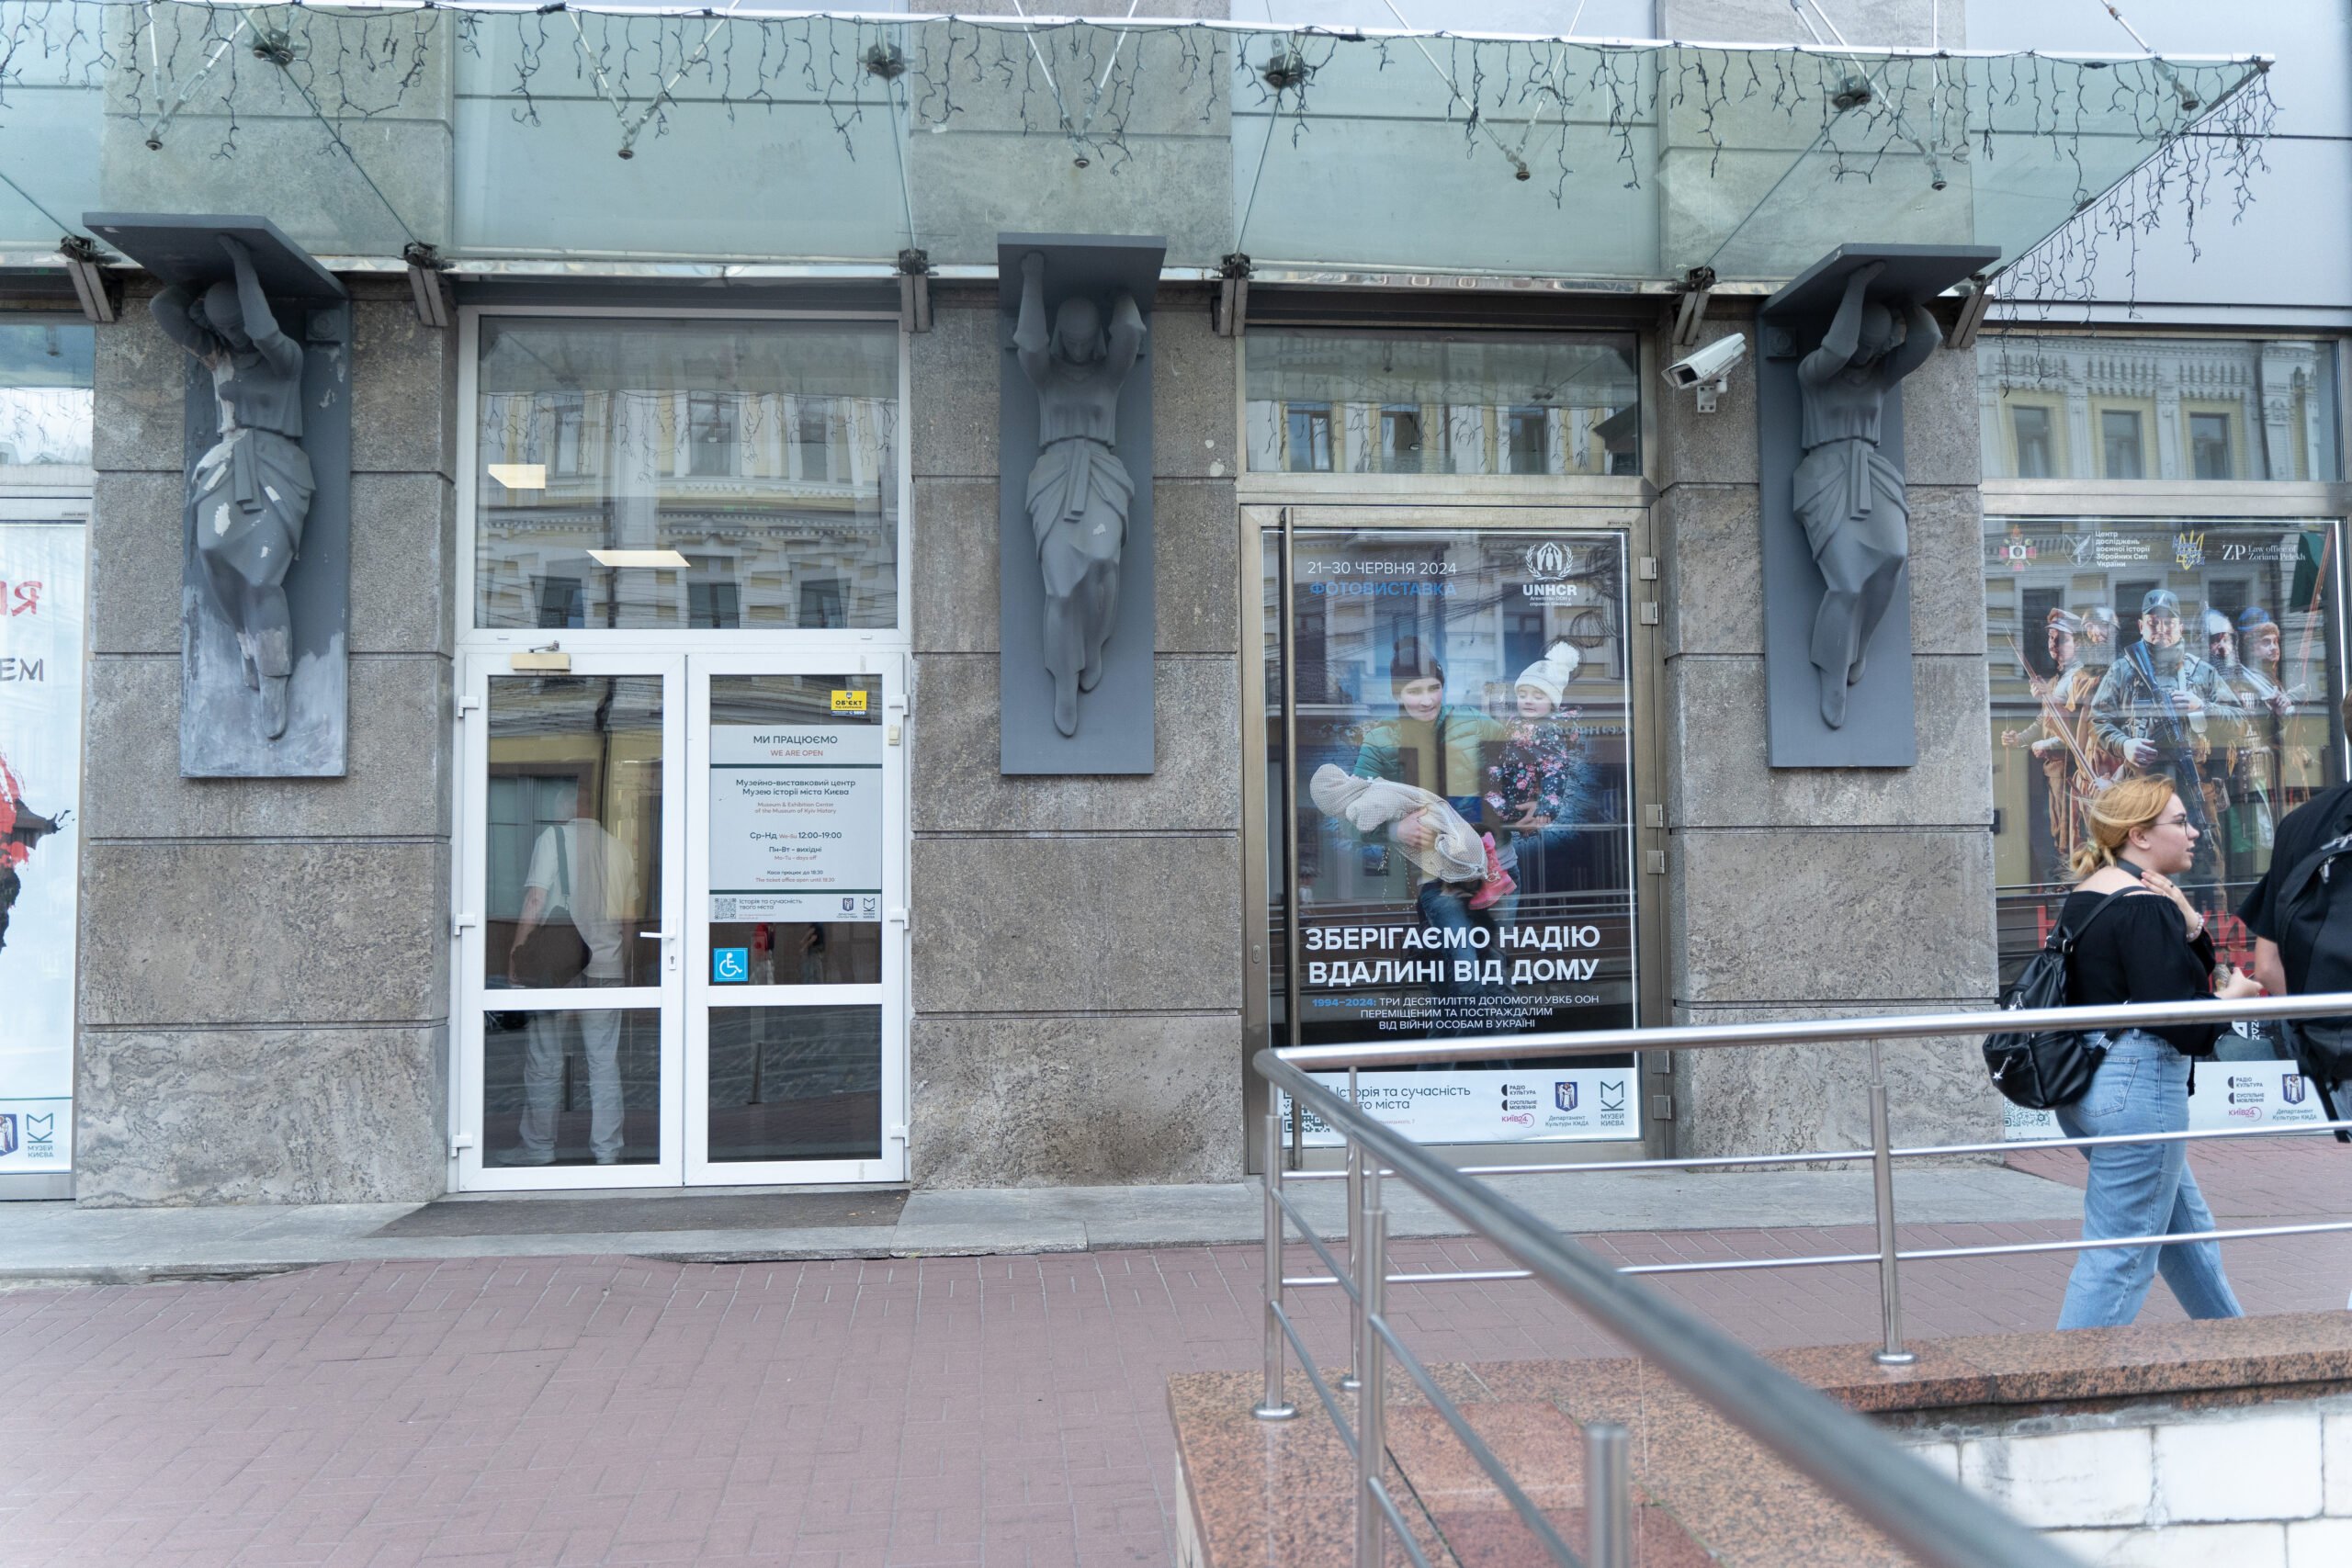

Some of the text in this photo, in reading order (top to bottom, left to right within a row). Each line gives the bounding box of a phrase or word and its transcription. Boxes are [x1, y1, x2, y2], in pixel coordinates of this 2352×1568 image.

[2222, 544, 2246, 560] ZP
[2248, 545, 2297, 553] Law office of
[1355, 561, 1414, 574] ЧЕРВНЯ
[1419, 562, 1457, 575] 2024
[1309, 581, 1457, 596] ФОТОВИСТАВКА
[1522, 584, 1577, 596] UNHCR
[753, 736, 838, 746] МИ ПРАЦЮЄМО
[736, 779, 829, 787] Музейно-виставковий
[742, 788, 771, 797] Музею
[773, 788, 798, 797] історії
[750, 832, 777, 841] Ср-Нд
[1305, 925, 1600, 952] ЗБЕРІГАЄМО НАДІЮ
[1308, 958, 1600, 987] ВДАЛИНІ ВІД ДОМУ
[1379, 998, 1400, 1007] ТРИ
[1402, 997, 1476, 1008] ДЕСЯТИЛІТТЯ
[1479, 996, 1543, 1007] ДОПОМОГИ
[1544, 996, 1573, 1004] УВКБ
[1575, 995, 1600, 1004] ООН
[1361, 1007, 1553, 1019] ПЕРЕМІЩЕНИМ ТА ПОСТРАЖДАЛИМ
[1379, 1018, 1535, 1031] ВІД ВІЙНИ ОСОБАМ В УКРАЇНІ
[2251, 1019, 2260, 1040] 202
[1383, 1089, 1397, 1097] та
[1400, 1084, 1471, 1100] сучасність
[1375, 1099, 1410, 1110] міста
